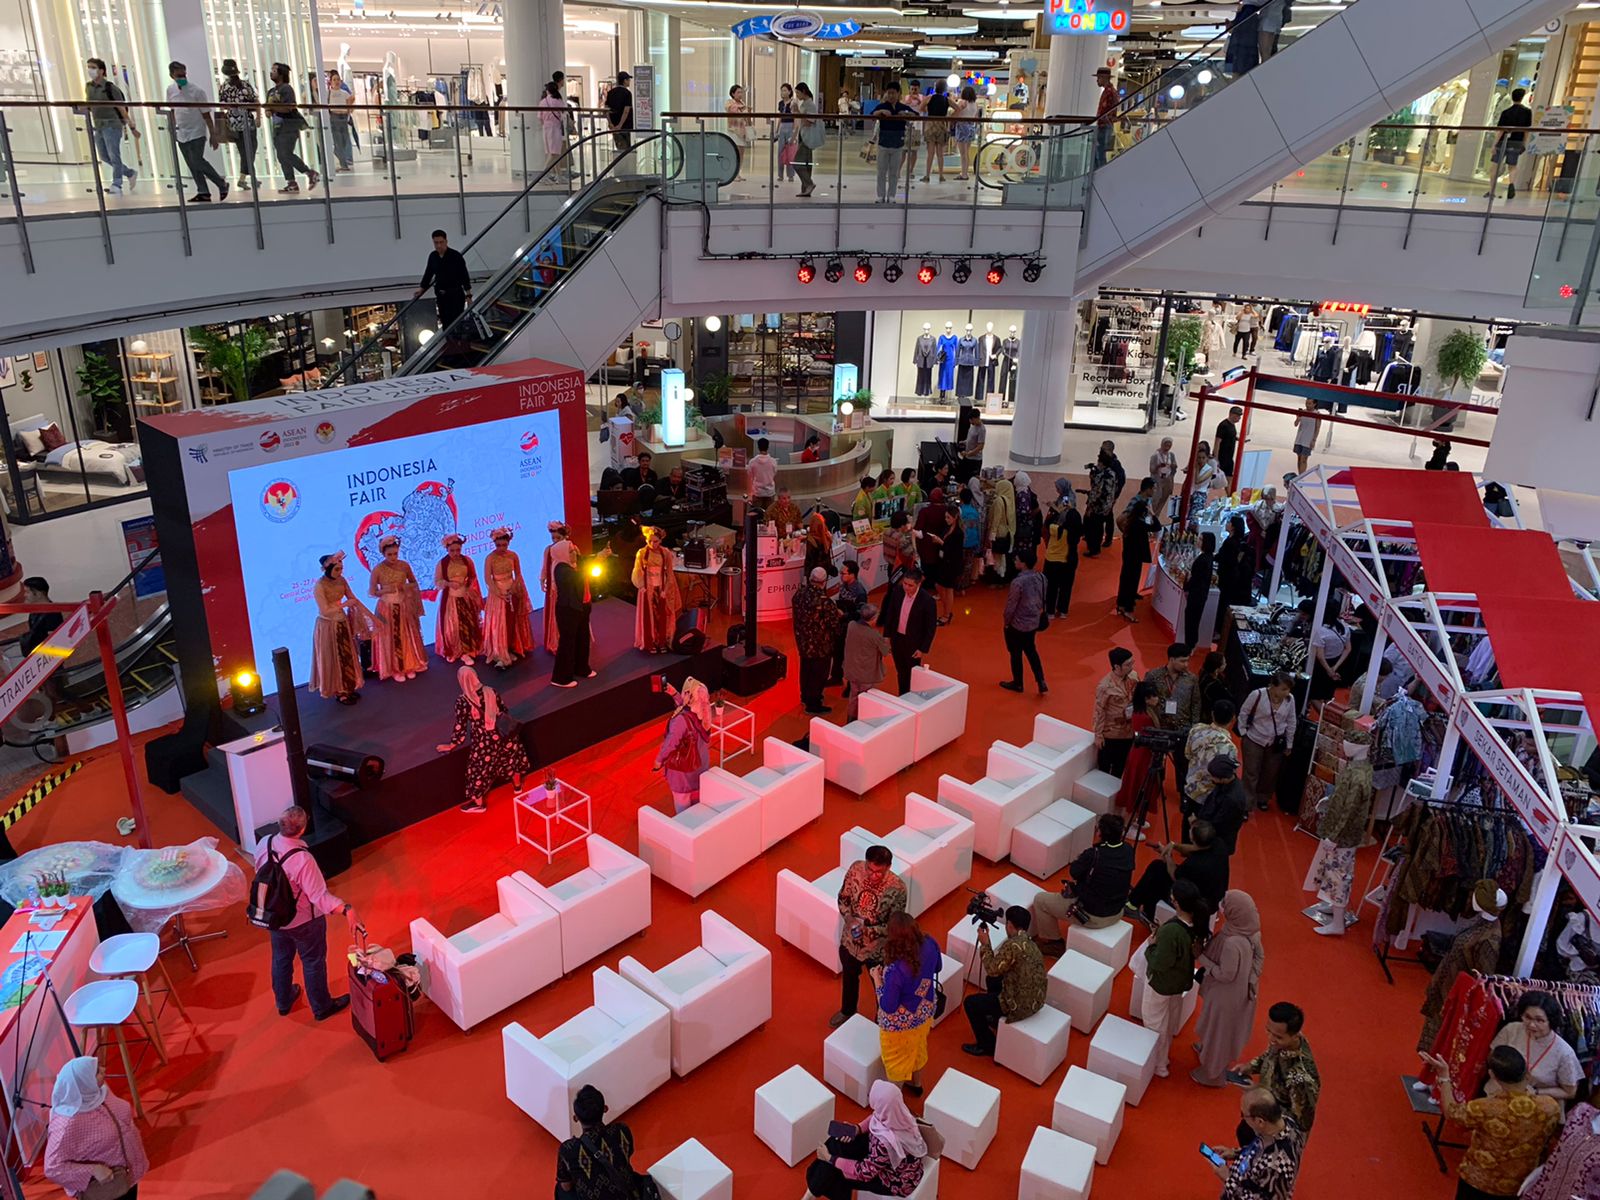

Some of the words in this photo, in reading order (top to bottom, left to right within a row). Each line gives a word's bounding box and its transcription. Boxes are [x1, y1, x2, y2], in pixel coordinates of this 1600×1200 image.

[1049, 0, 1096, 14] PLAY
[1055, 9, 1127, 31] MONDO
[1114, 306, 1155, 318] Women
[1130, 322, 1153, 332] Men
[1127, 349, 1150, 359] Kids
[519, 376, 582, 398] INDONESIA
[1083, 372, 1123, 385] Recycle
[1126, 375, 1146, 386] Box
[274, 373, 473, 407] INDONESIA
[1092, 386, 1114, 396] And
[1116, 389, 1144, 399] more
[293, 394, 376, 414] FAIR
[520, 394, 546, 411] FAIR
[551, 389, 576, 405] 2023
[282, 426, 307, 438] ASEAN
[520, 456, 542, 468] ASEAN
[347, 458, 438, 489] INDONESIA
[349, 487, 387, 507] FAIR
[474, 512, 505, 528] KNOW
[464, 541, 496, 556] BETTE
[0, 667, 37, 708] TRAVEL
[1473, 729, 1497, 767] SEKAR
[1495, 758, 1533, 810] SETAMAN
